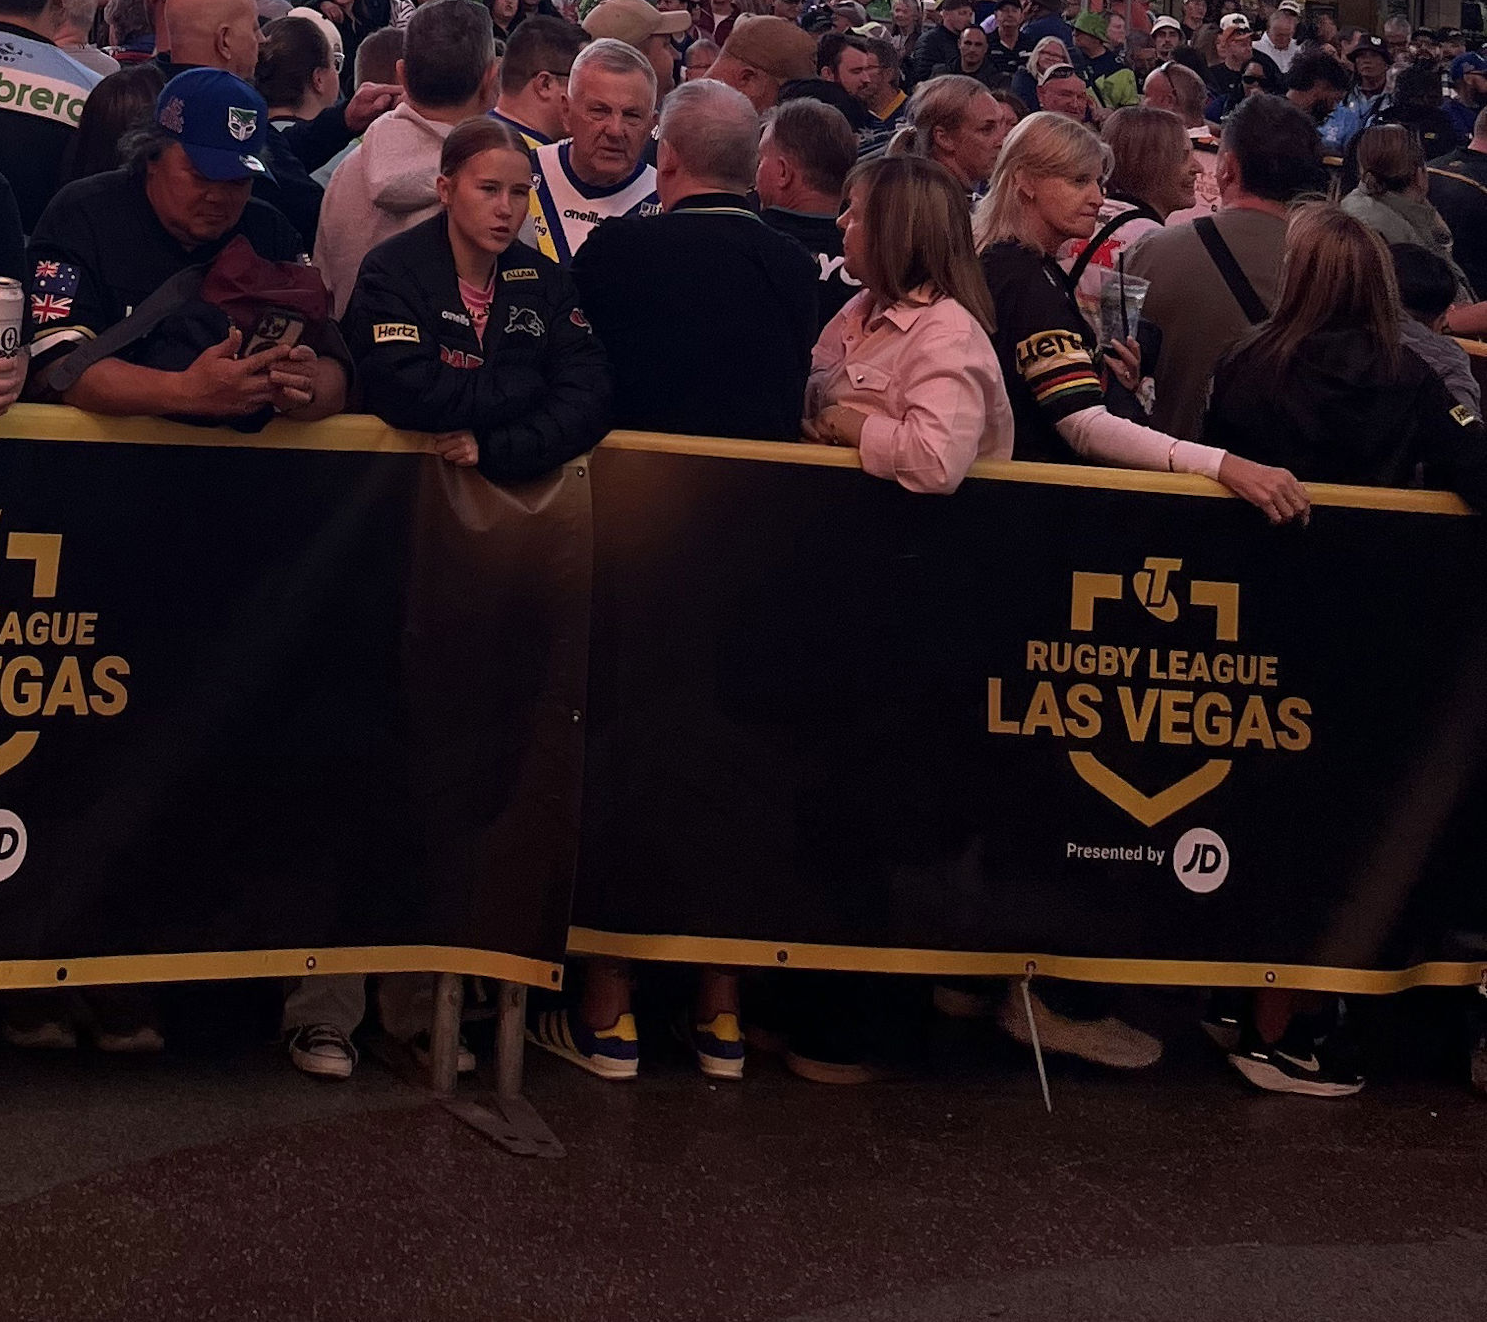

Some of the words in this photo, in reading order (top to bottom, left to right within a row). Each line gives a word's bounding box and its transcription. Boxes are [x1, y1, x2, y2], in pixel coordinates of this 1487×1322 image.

[377, 325, 416, 339] Hertz
[1026, 640, 1140, 678] RUGBY
[1148, 648, 1278, 687] LEAGUE
[988, 677, 1103, 739] LAS
[1117, 686, 1312, 751] VEGAS
[1066, 842, 1143, 862] Presented
[1147, 845, 1166, 866] by
[1182, 843, 1222, 874] JD
